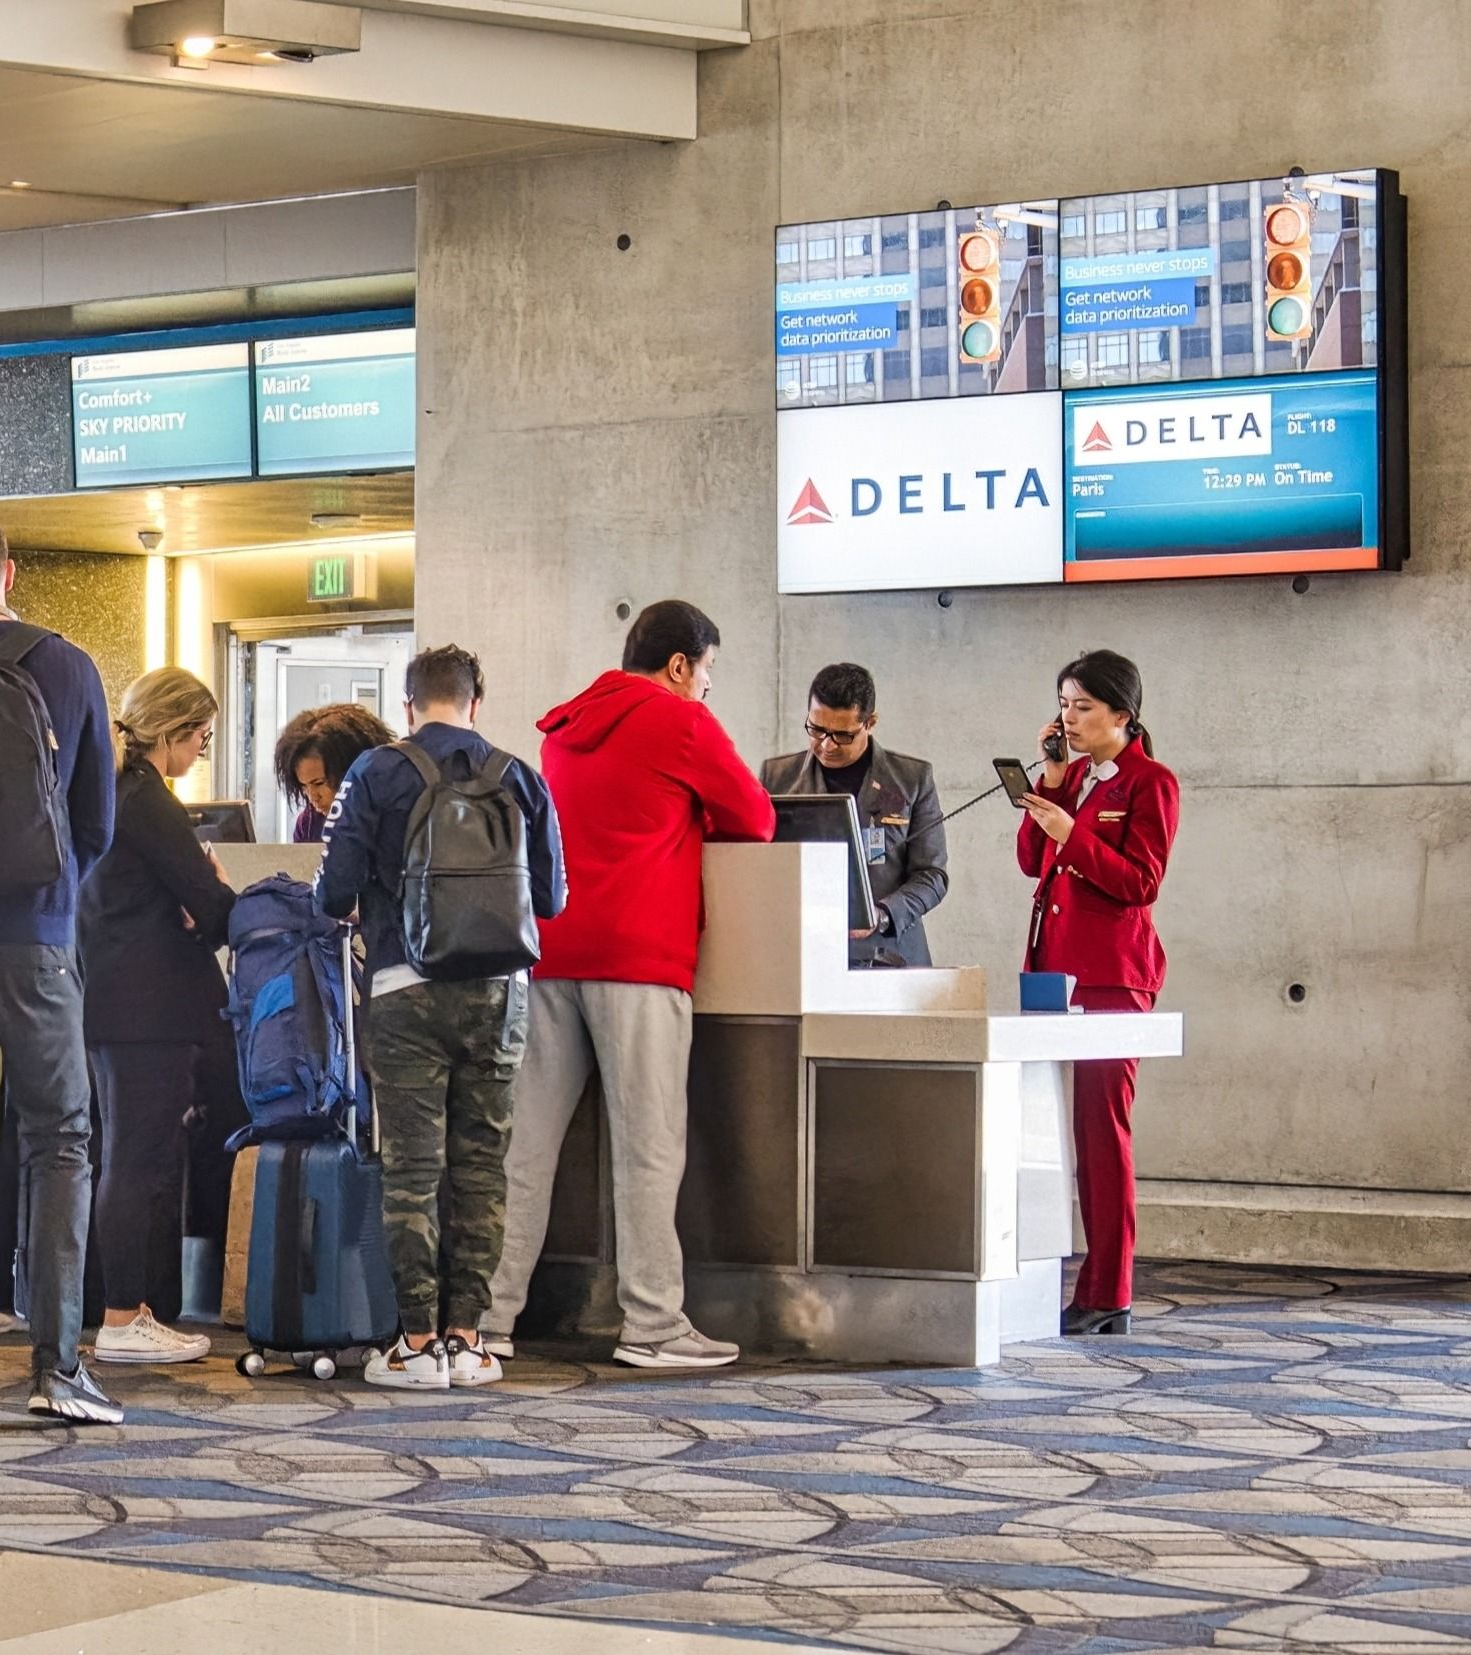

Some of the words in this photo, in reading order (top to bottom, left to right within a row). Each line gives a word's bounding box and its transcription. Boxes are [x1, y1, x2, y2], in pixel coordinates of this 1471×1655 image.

[1065, 263, 1123, 279] Business
[1126, 260, 1165, 274] never
[1169, 256, 1208, 272] stops
[780, 289, 832, 305] Business
[835, 286, 869, 299] never
[872, 281, 909, 298] stops
[1065, 291, 1090, 306] Get
[1093, 286, 1151, 303] network
[781, 315, 803, 330] Get
[805, 311, 858, 326] network
[1066, 309, 1096, 325] data
[1099, 303, 1189, 323] prioritization
[781, 331, 809, 347] data
[812, 326, 891, 347] prioritization
[262, 375, 311, 395] Main2
[79, 390, 153, 409] Comfort+
[263, 404, 284, 423] All
[289, 401, 380, 421] Customers
[79, 418, 108, 437] SKY
[113, 412, 187, 433] PRIORITY
[1126, 412, 1262, 447] DELTA
[1287, 420, 1306, 435] DL
[1309, 418, 1336, 433] 118
[80, 445, 127, 464] Main1
[1204, 473, 1243, 489] 12:29
[1246, 472, 1267, 487] PM
[1274, 471, 1295, 485] On
[1297, 470, 1334, 484] Time
[851, 467, 1050, 517] DELTA
[1072, 482, 1105, 497] Paris
[315, 558, 345, 595] EXIT
